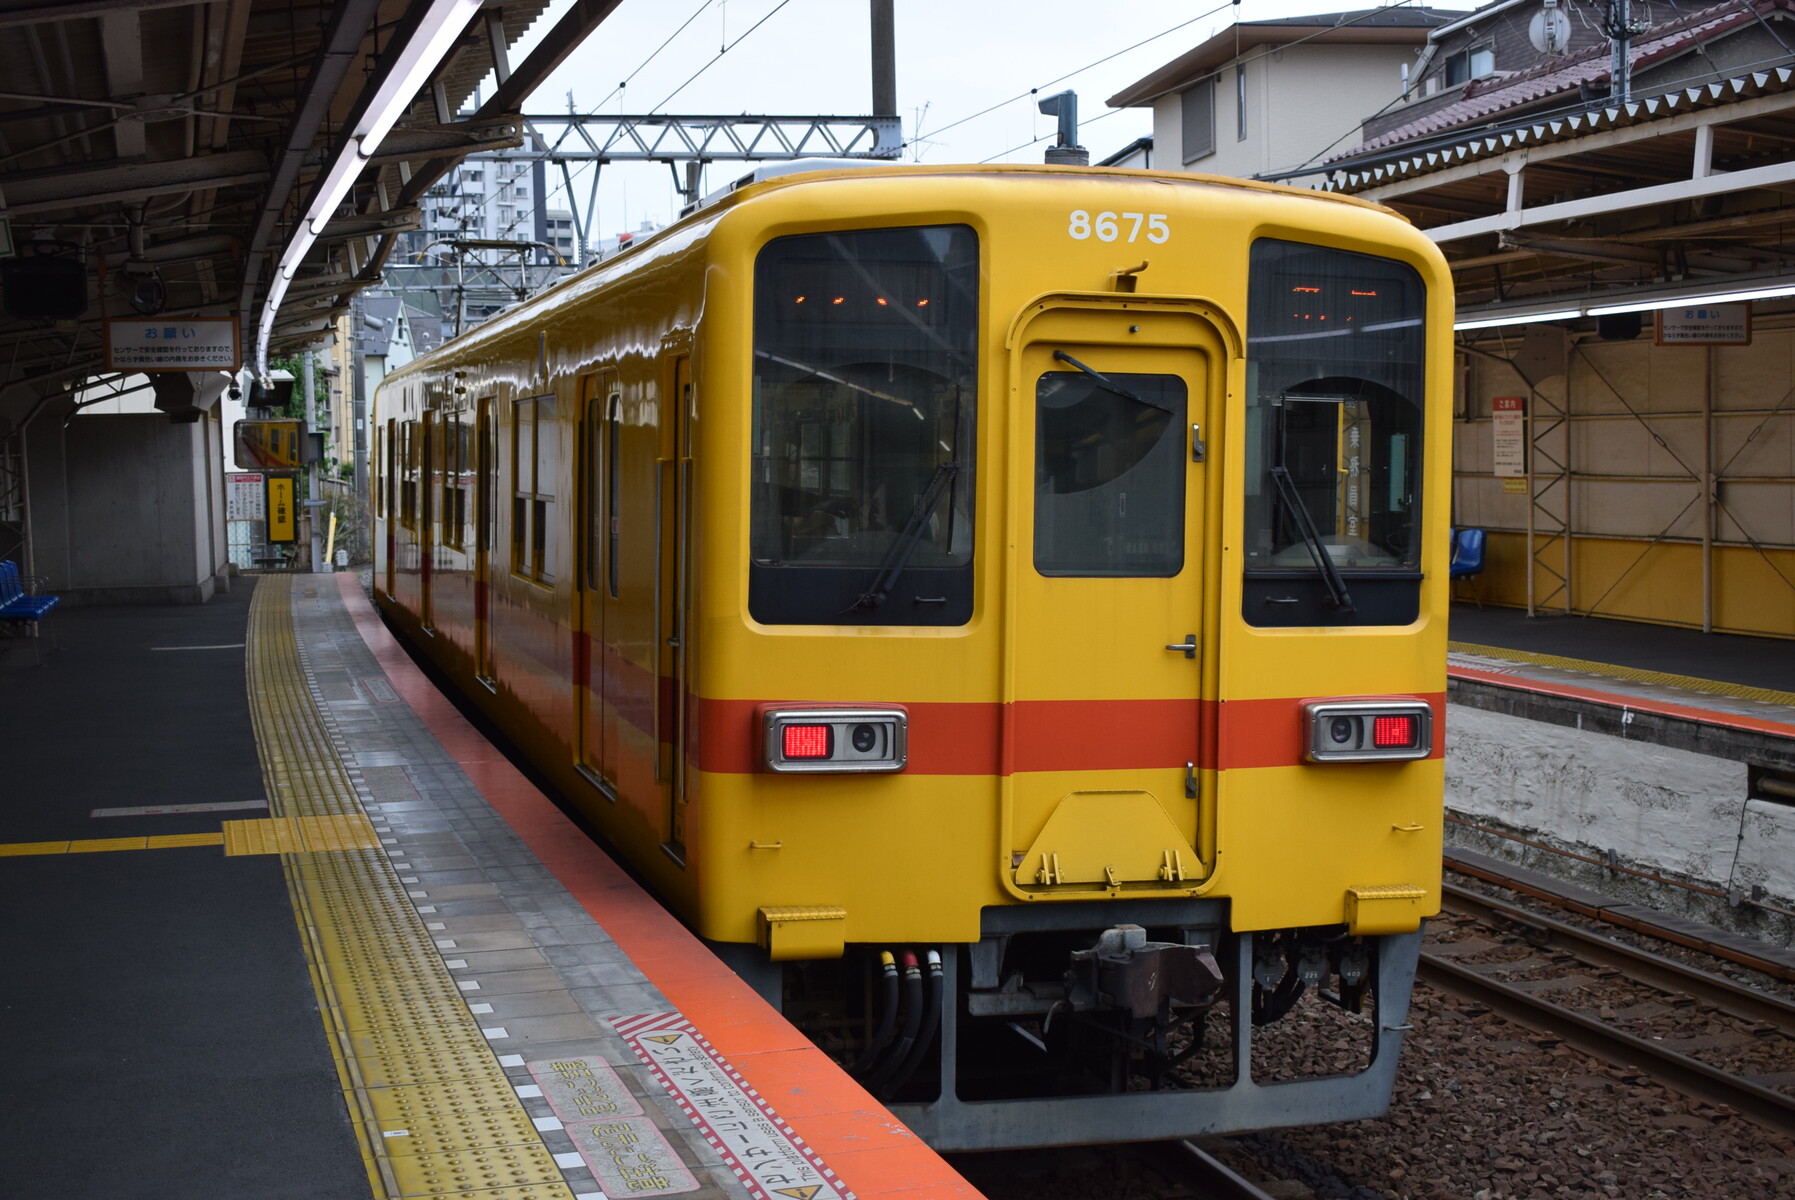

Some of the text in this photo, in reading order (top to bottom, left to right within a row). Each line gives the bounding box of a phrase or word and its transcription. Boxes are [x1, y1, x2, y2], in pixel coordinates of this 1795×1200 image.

[1067, 209, 1171, 245] 8675
[144, 327, 196, 339] お願い
[735, 1097, 759, 1117] sensor
[757, 1123, 779, 1137] uses
[772, 1138, 806, 1165] platform
[797, 1166, 818, 1182] This
